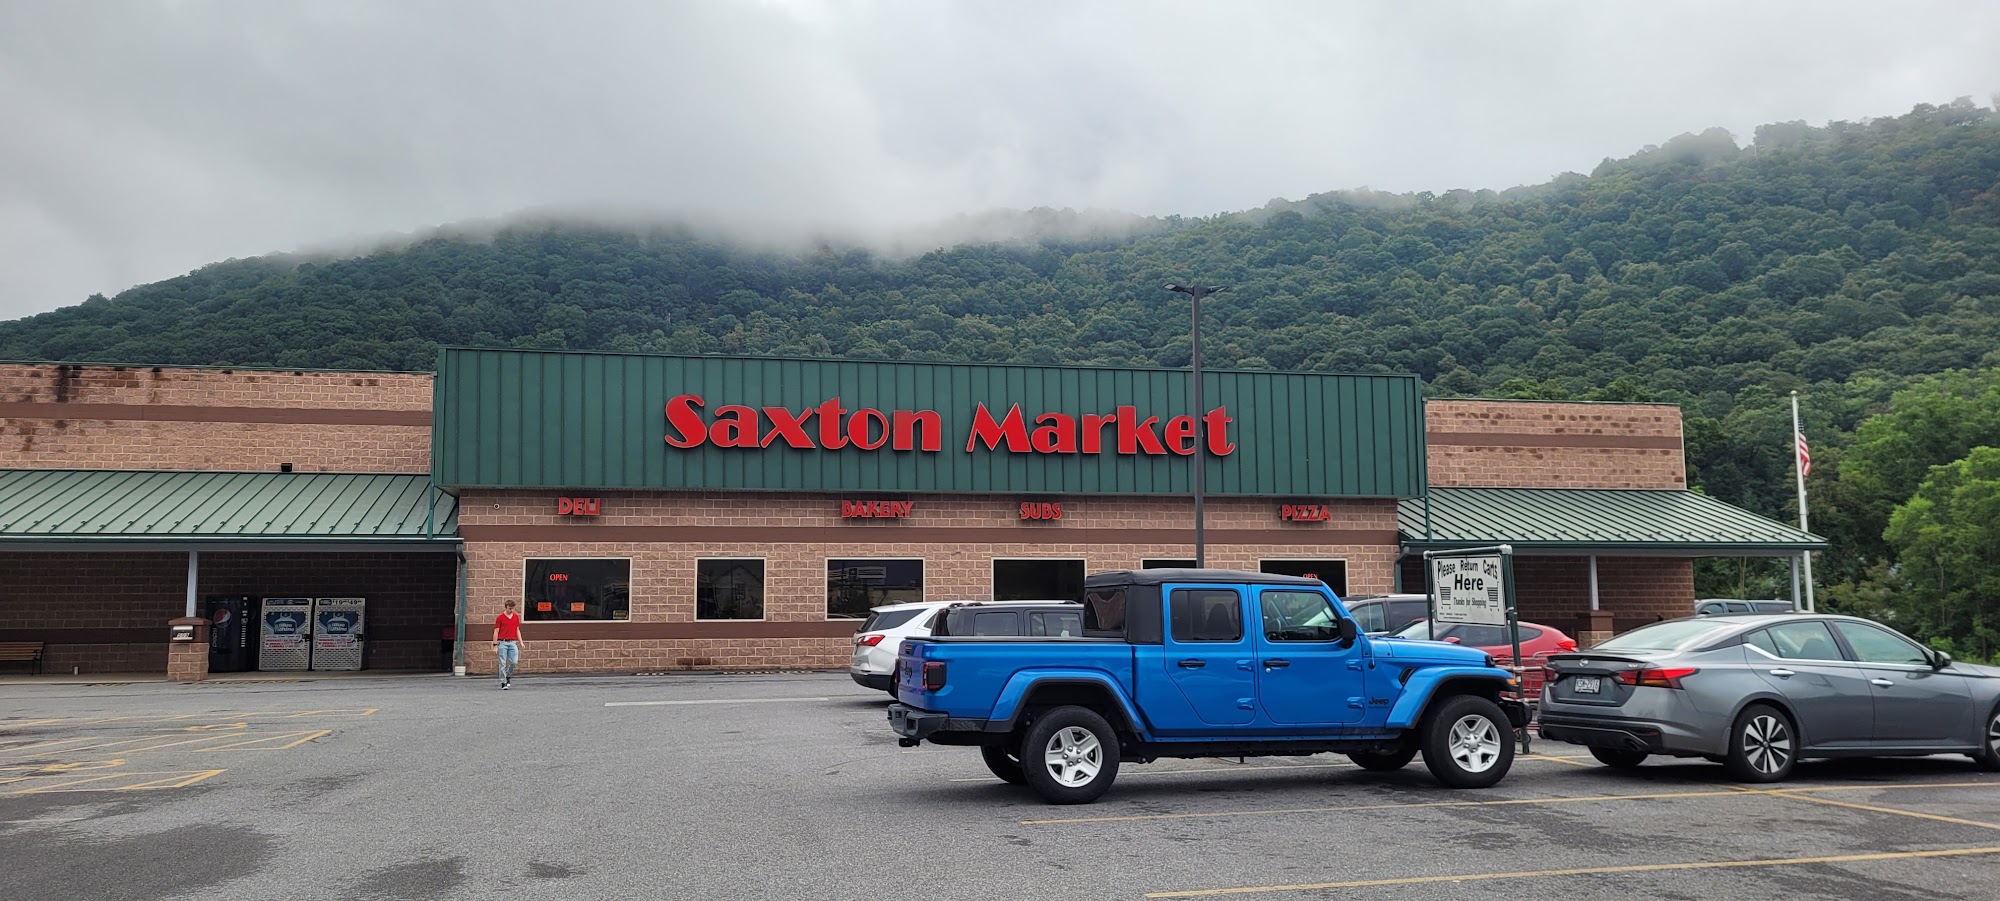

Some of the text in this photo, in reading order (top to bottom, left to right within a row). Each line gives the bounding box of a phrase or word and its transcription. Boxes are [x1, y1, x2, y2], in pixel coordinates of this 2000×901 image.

[665, 394, 1236, 456] Saxton Market
[558, 497, 600, 516] DELI
[841, 500, 914, 518] BAKERY
[1020, 501, 1062, 520] SUBS
[1281, 504, 1331, 521] PIZZA
[549, 573, 569, 582] OPEN
[1437, 559, 1498, 580] Please Return Carts
[1454, 574, 1483, 590] Here
[1368, 696, 1389, 705] Jeep
